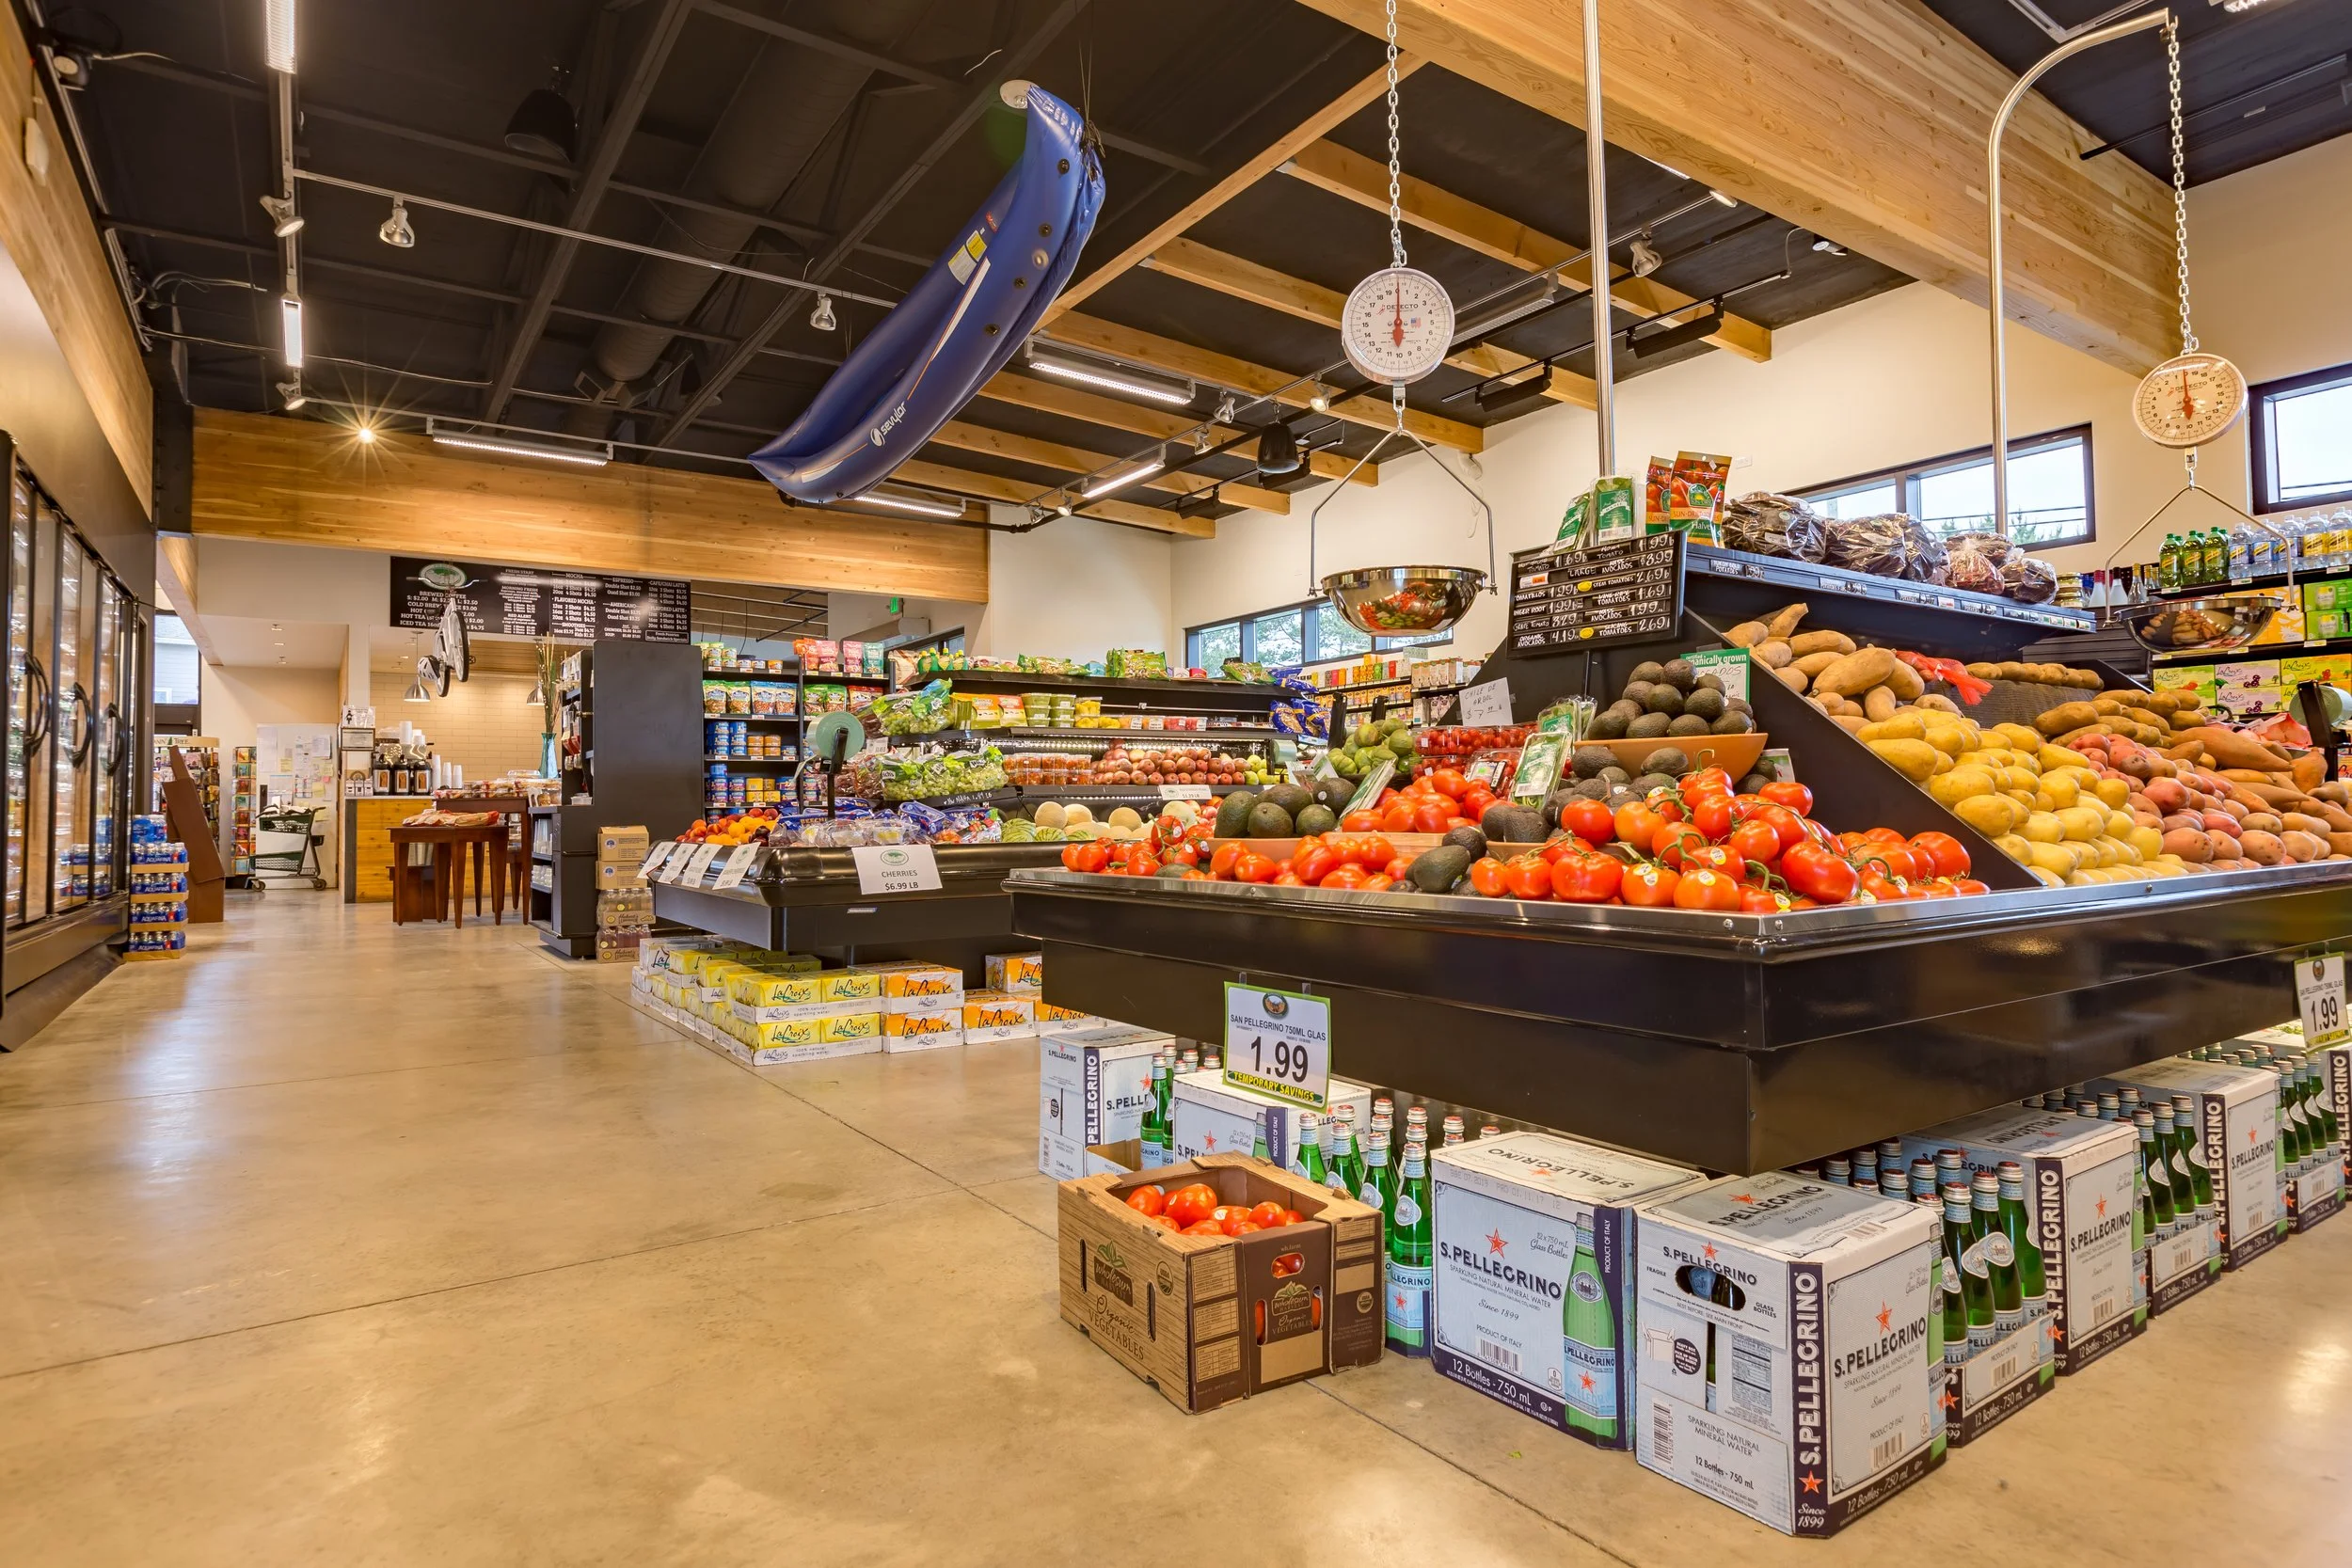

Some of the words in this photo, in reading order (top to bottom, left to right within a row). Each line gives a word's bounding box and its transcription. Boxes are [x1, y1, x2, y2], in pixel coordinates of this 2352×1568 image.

[881, 401, 906, 436] sevylor
[1597, 550, 1623, 559] TOMATO
[1568, 567, 1597, 577] LARGE
[1601, 562, 1632, 574] AVOCADOS
[1609, 577, 1634, 586] TOMATOES
[1597, 595, 1630, 605] TOMATOES
[1591, 611, 1622, 622] AVOCADOS
[1599, 627, 1632, 636] TOMATOES
[1518, 639, 1545, 647] AVOCADOS
[1724, 655, 1746, 663] grown
[2217, 665, 2242, 676] LaCroix
[1465, 688, 1483, 699] CHILE
[1488, 683, 1496, 692] DE
[2218, 691, 2245, 702] LaCroix
[881, 869, 917, 878] CHERRIES
[884, 881, 907, 891] $6.99
[909, 881, 919, 890] LB
[772, 985, 811, 1002] LaCroix
[834, 978, 870, 997] LaCroix
[977, 1008, 1028, 1029] LaCroix
[2312, 996, 2338, 1032] 1.99
[771, 1025, 811, 1042] LaCroix
[833, 1019, 870, 1037] LaCroix
[1231, 1014, 1243, 1023] SAN
[1244, 1018, 1284, 1032] PELLEGRINO
[1285, 1025, 1306, 1037] 750ML
[1307, 1030, 1327, 1041] GLAS
[1048, 1050, 1076, 1063] S.PELLEGRINO
[1250, 1036, 1309, 1083] 1.99
[1233, 1071, 1279, 1091] TEMPORARY
[1279, 1084, 1314, 1101] SAVINGS
[2232, 1139, 2274, 1170] S.PELLEGRINO
[1486, 1147, 1636, 1190] S.PELLEGRINO
[1708, 1185, 1825, 1227] S.PELLEGRINO
[1604, 1234, 1610, 1245] OF
[2070, 1211, 2131, 1253] S.PELLEGRINO
[1531, 1239, 1546, 1252] Glass
[1548, 1244, 1568, 1259] Bottles
[2040, 1169, 2063, 1322] S.PELLEGRINO
[1440, 1241, 1562, 1301] S.PELLEGRINO
[1646, 1266, 1666, 1277] FRAGILE
[1662, 1245, 1757, 1286] S.PELLEGRINO
[1450, 1264, 1478, 1281] SPARKLING
[1479, 1274, 1504, 1291] NATURAL
[1505, 1285, 1530, 1301] MINERAL
[1531, 1295, 1551, 1308] WATER
[1274, 1296, 1309, 1309] wholesum
[1478, 1299, 1499, 1315] Since
[1501, 1307, 1519, 1321] 1899
[1754, 1306, 1777, 1319] BOTTLES
[1756, 1302, 1774, 1312] GLASS
[1096, 1294, 1135, 1334] Organic
[1279, 1314, 1307, 1327] Organic
[1089, 1308, 1144, 1360] VEGETABLES
[1476, 1324, 1500, 1340] PRODUCT
[1501, 1334, 1508, 1342] OF
[1508, 1337, 1522, 1349] ITALY
[1835, 1317, 1926, 1378] S.PELLEGRINO
[2078, 1345, 2085, 1358] 12
[2085, 1338, 2101, 1356] Bottles
[1794, 1272, 1822, 1466] S.PELLEGRINO
[1843, 1369, 1870, 1389] SPARKLING
[1871, 1363, 1891, 1377] NATURAL
[1452, 1358, 1463, 1374] 12
[1464, 1364, 1491, 1387] Bottles
[1497, 1379, 1517, 1398] 750
[1518, 1392, 1532, 1406] mL
[1975, 1414, 1982, 1429] 12
[1983, 1403, 2000, 1423] Bottles
[2003, 1395, 2015, 1411] 750
[1687, 1415, 1725, 1436] SPARKLING
[1726, 1432, 1760, 1452] NATURAL
[1869, 1427, 1889, 1440] PRODUCT
[1895, 1416, 1905, 1425] ITALY
[1694, 1427, 1726, 1445] MINERAL
[1727, 1440, 1754, 1457] WATER
[1695, 1455, 1703, 1466] 12
[1704, 1460, 1724, 1476] Bottles
[1729, 1470, 1742, 1484] 750
[1744, 1481, 1754, 1490] mL
[1847, 1500, 1855, 1514] 12
[1857, 1486, 1880, 1507] Bottles
[1883, 1472, 1899, 1493] 750
[1798, 1502, 1826, 1515] Since
[1797, 1516, 1825, 1528] 1899
